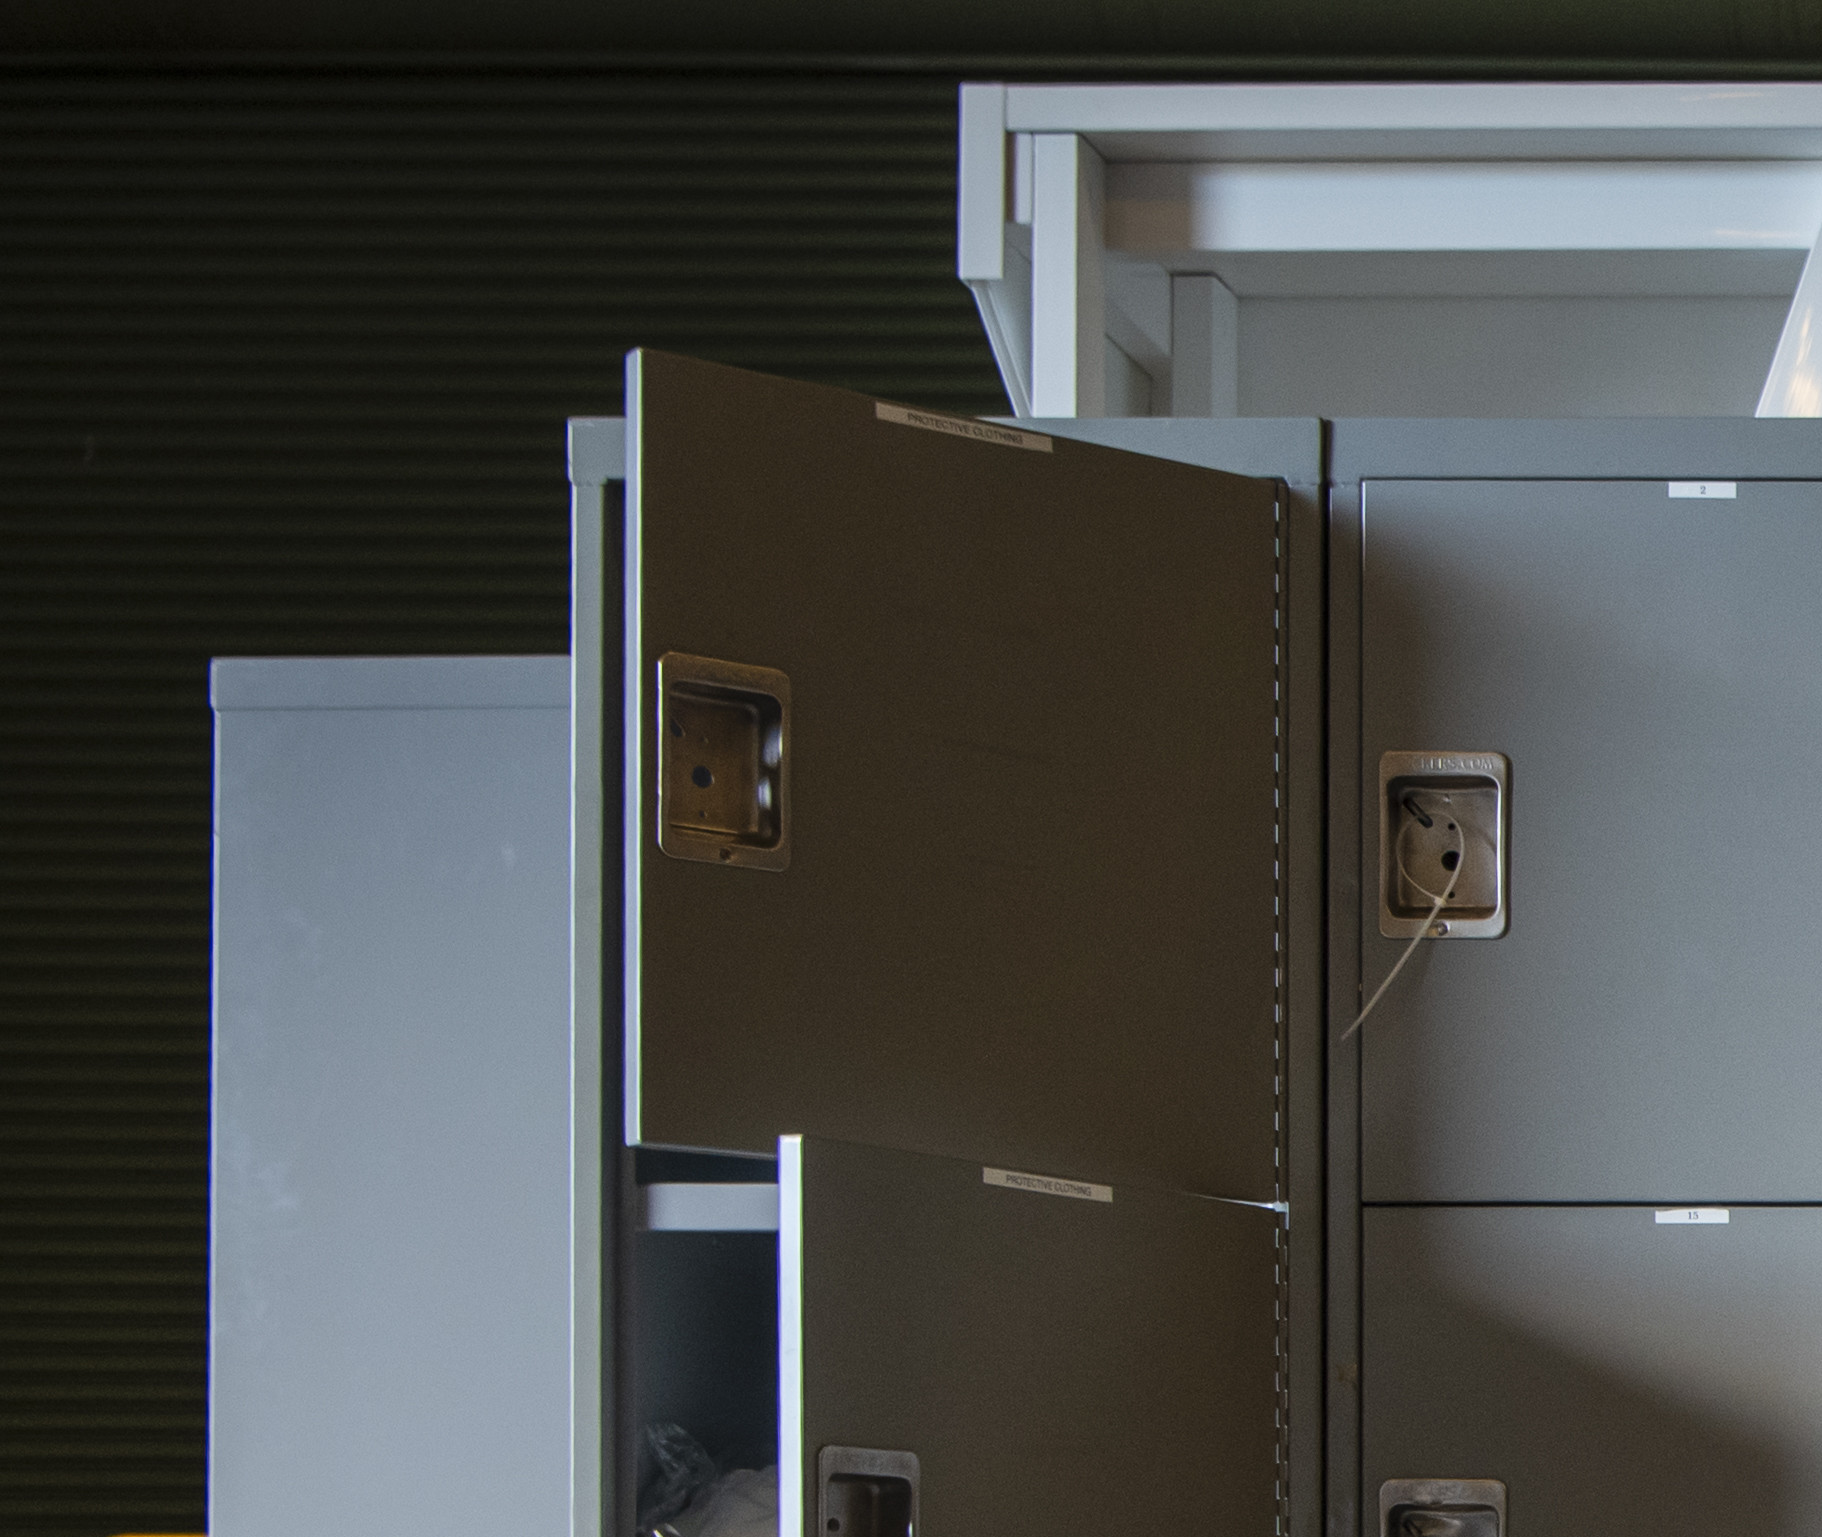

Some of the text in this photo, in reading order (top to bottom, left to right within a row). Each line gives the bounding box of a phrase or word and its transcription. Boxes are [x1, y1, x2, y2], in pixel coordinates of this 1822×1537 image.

[906, 412, 1024, 445] PROTECTIVE CLOTHING
[1700, 485, 1707, 495] 2
[1005, 1174, 1092, 1197] PROTECTIVE CLOTHING
[1688, 1211, 1699, 1220] 15
